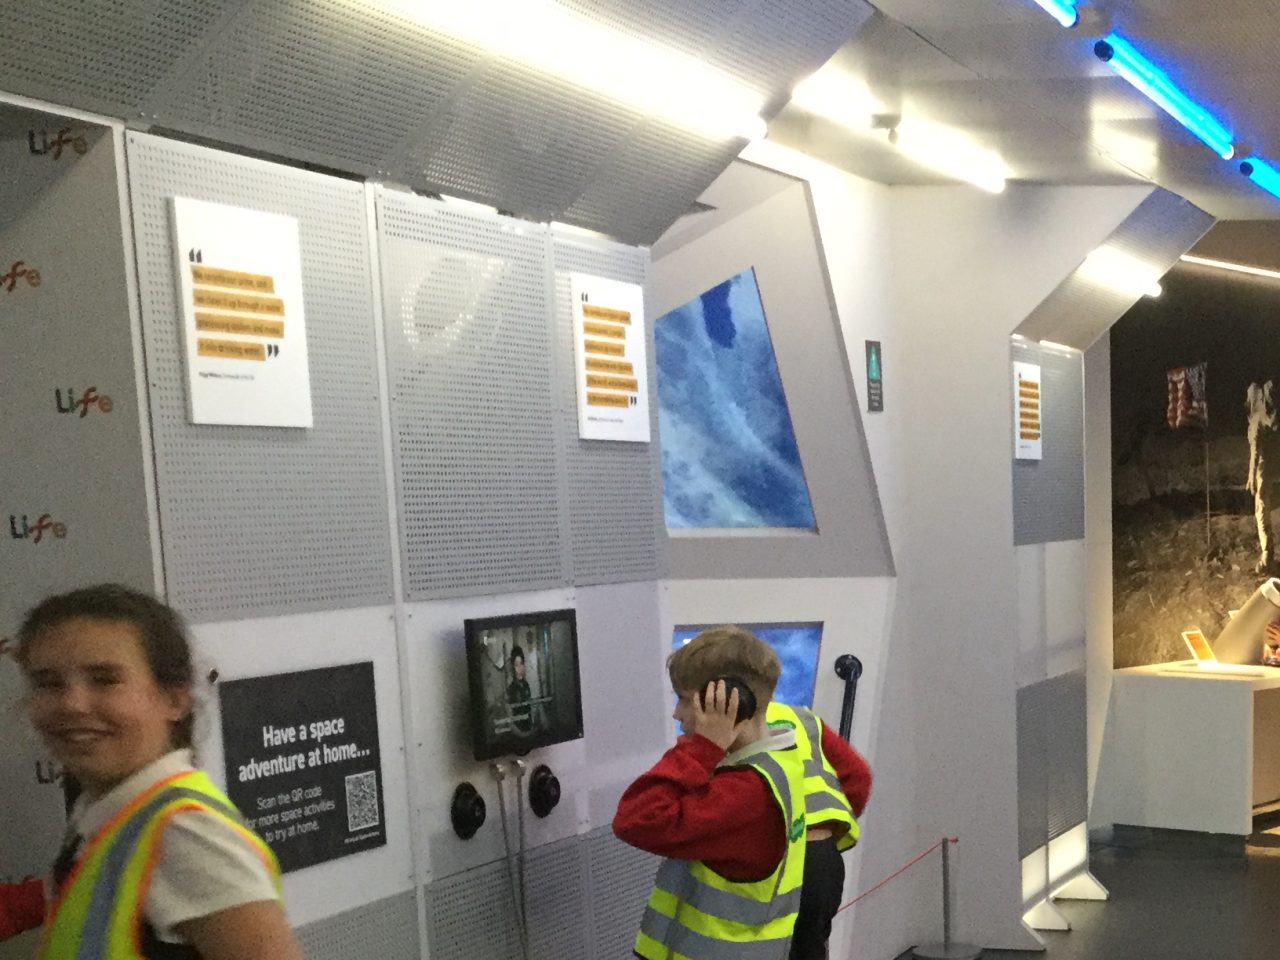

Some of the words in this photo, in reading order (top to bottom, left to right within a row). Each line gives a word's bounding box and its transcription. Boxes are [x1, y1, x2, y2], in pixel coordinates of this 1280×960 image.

[55, 386, 114, 418] Life
[10, 513, 68, 544] Life
[262, 724, 296, 748] Have
[299, 724, 307, 740] a
[309, 717, 345, 743] space
[238, 753, 305, 783] adventure
[308, 748, 321, 767] at
[323, 742, 370, 764] home...
[257, 796, 276, 810] Scan
[277, 793, 291, 805] the
[291, 788, 303, 802] QR
[304, 786, 322, 799] code
[258, 813, 279, 826] more
[281, 807, 303, 822] space
[303, 799, 336, 817] activities
[265, 831, 274, 843] to
[275, 828, 287, 842] try
[288, 825, 295, 837] at
[296, 820, 320, 834] home.
